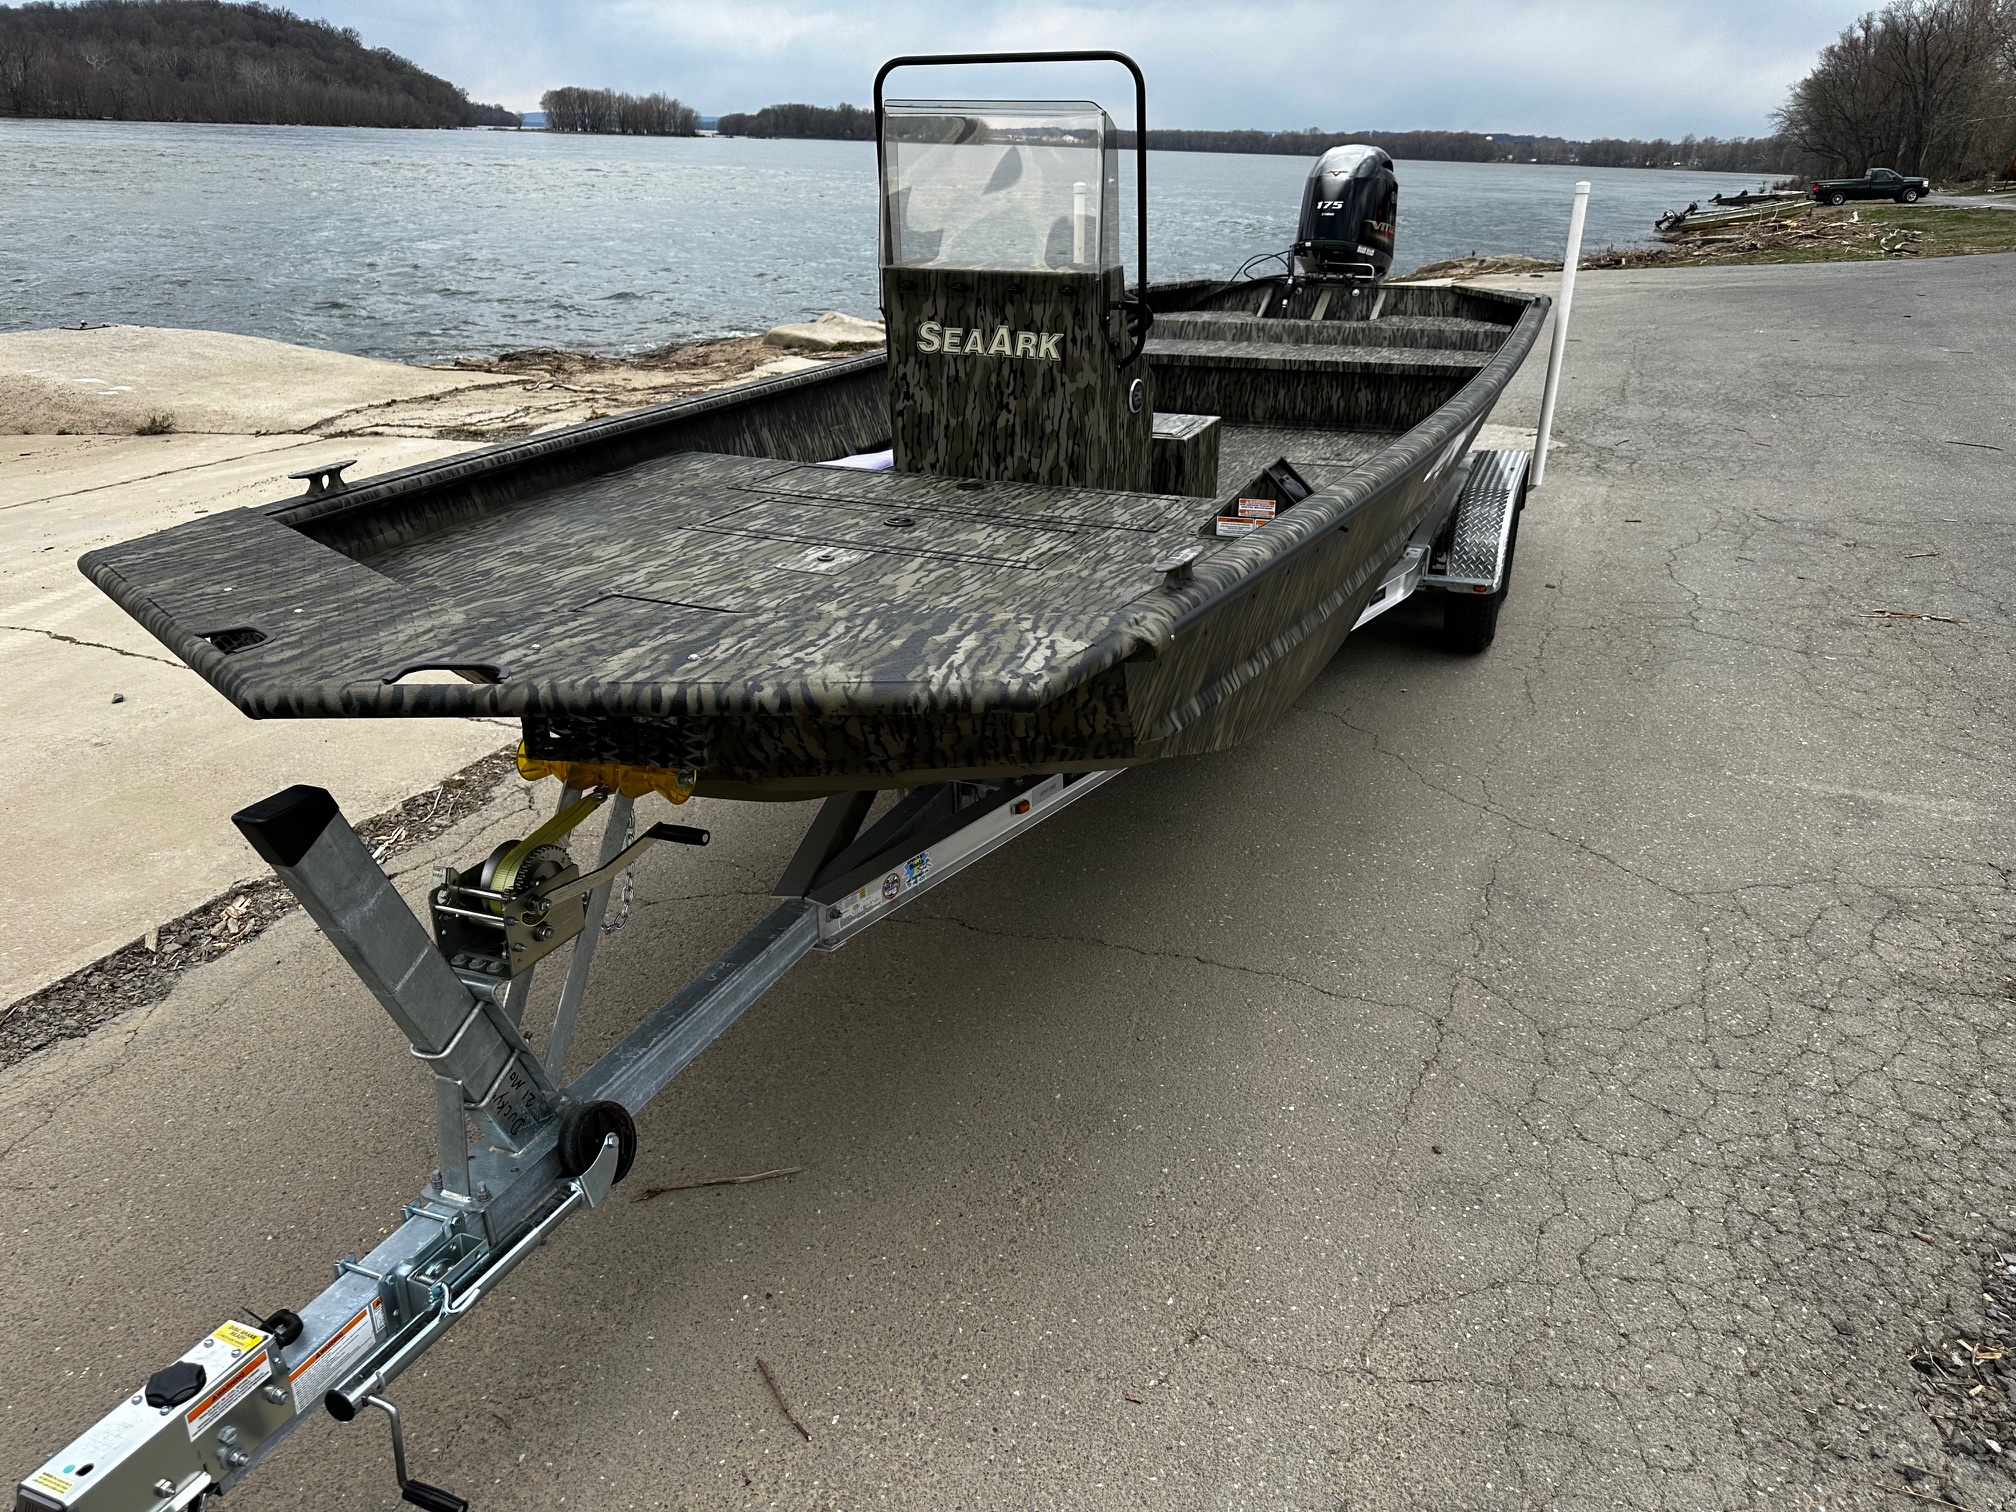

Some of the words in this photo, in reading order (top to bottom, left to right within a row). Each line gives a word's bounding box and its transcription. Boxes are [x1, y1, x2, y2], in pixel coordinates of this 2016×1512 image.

[1317, 201, 1344, 209] 175
[1039, 783, 1056, 797] VENTURE
[230, 1331, 247, 1341] READY
[240, 1330, 258, 1340] BRAKE
[216, 1371, 246, 1397] WARNING
